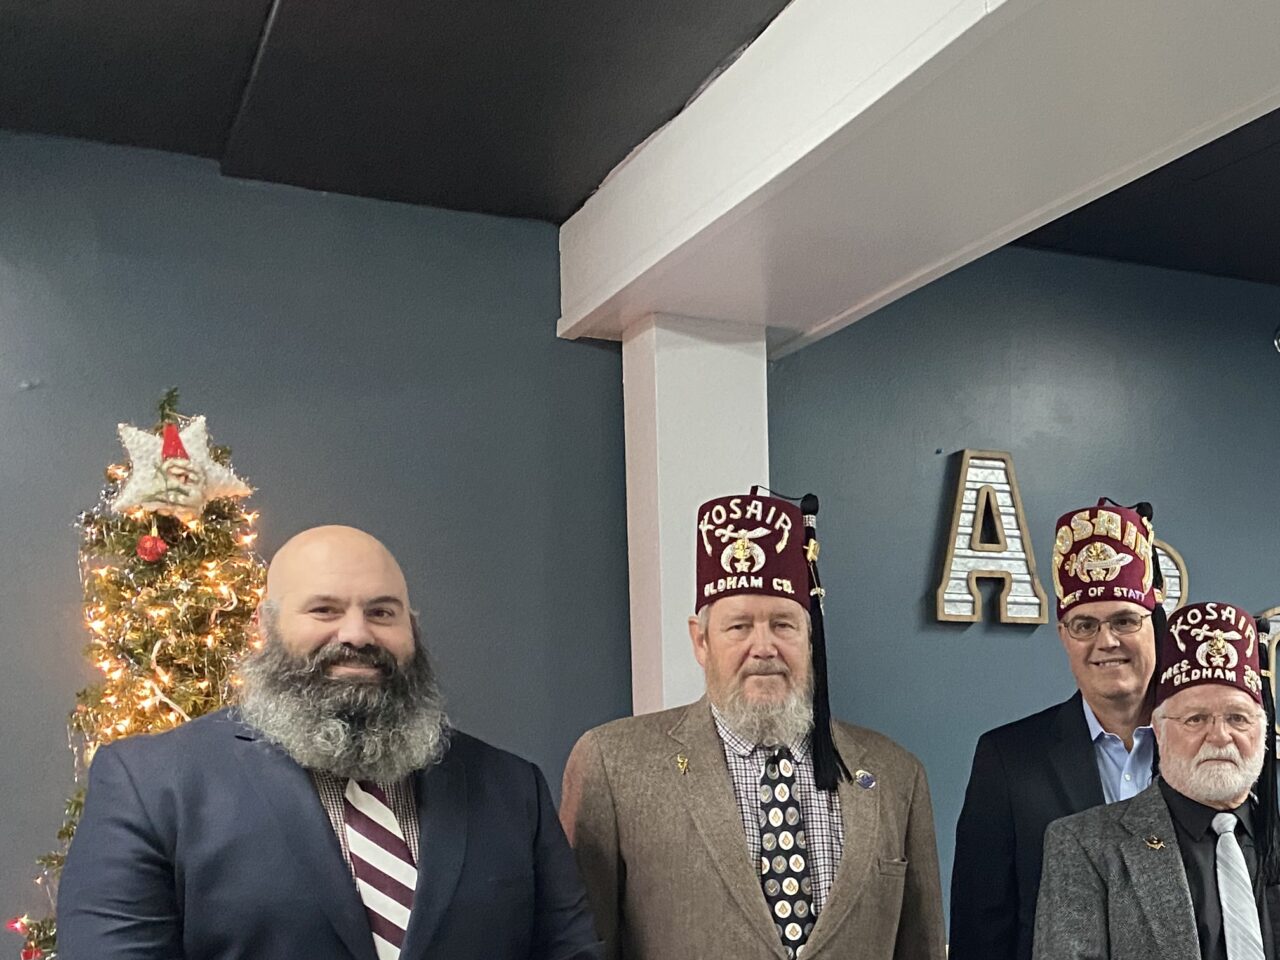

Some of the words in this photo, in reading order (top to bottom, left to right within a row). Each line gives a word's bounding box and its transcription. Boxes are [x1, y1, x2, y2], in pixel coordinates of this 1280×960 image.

[699, 498, 792, 557] KOSAIR
[704, 576, 763, 597] OLDHAM
[1088, 587, 1105, 597] OF
[1169, 602, 1256, 659] KOSAIR
[1173, 668, 1237, 687] OLDHAM
